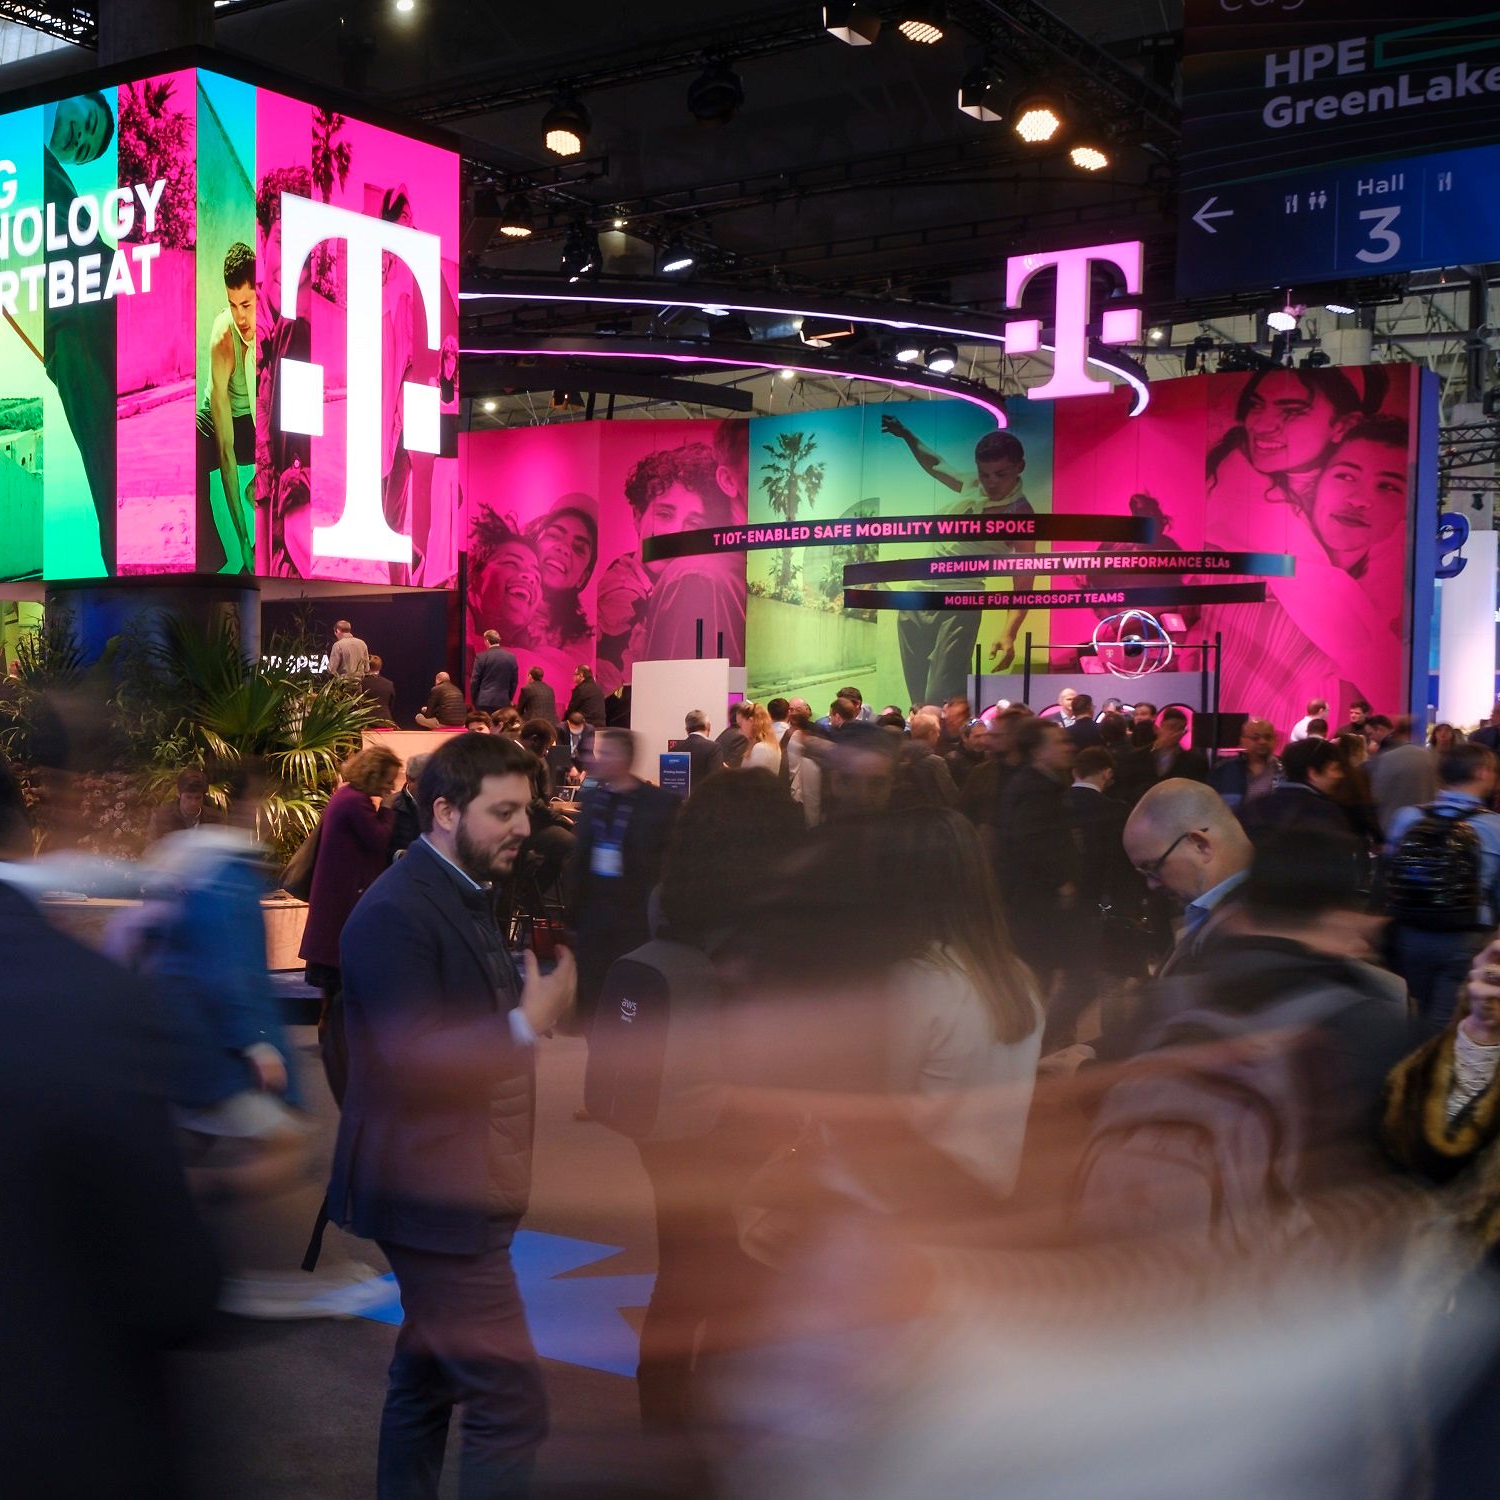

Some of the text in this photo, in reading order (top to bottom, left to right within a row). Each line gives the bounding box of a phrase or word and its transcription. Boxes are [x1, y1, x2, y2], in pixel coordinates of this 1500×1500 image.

[1264, 37, 1367, 88] HPE
[1263, 62, 1500, 128] GreenLake
[1357, 173, 1404, 197] Hall
[1355, 205, 1402, 264] 3
[713, 520, 1035, 545] T IOT-ENABLED SAFE MOBILITY WITH SPOKE
[930, 556, 1230, 573] PREMIUM INTERNET WITH PERFORMANCE SLAs
[945, 592, 1125, 606] MOBILE FÜR MICROSOFT TEAMS
